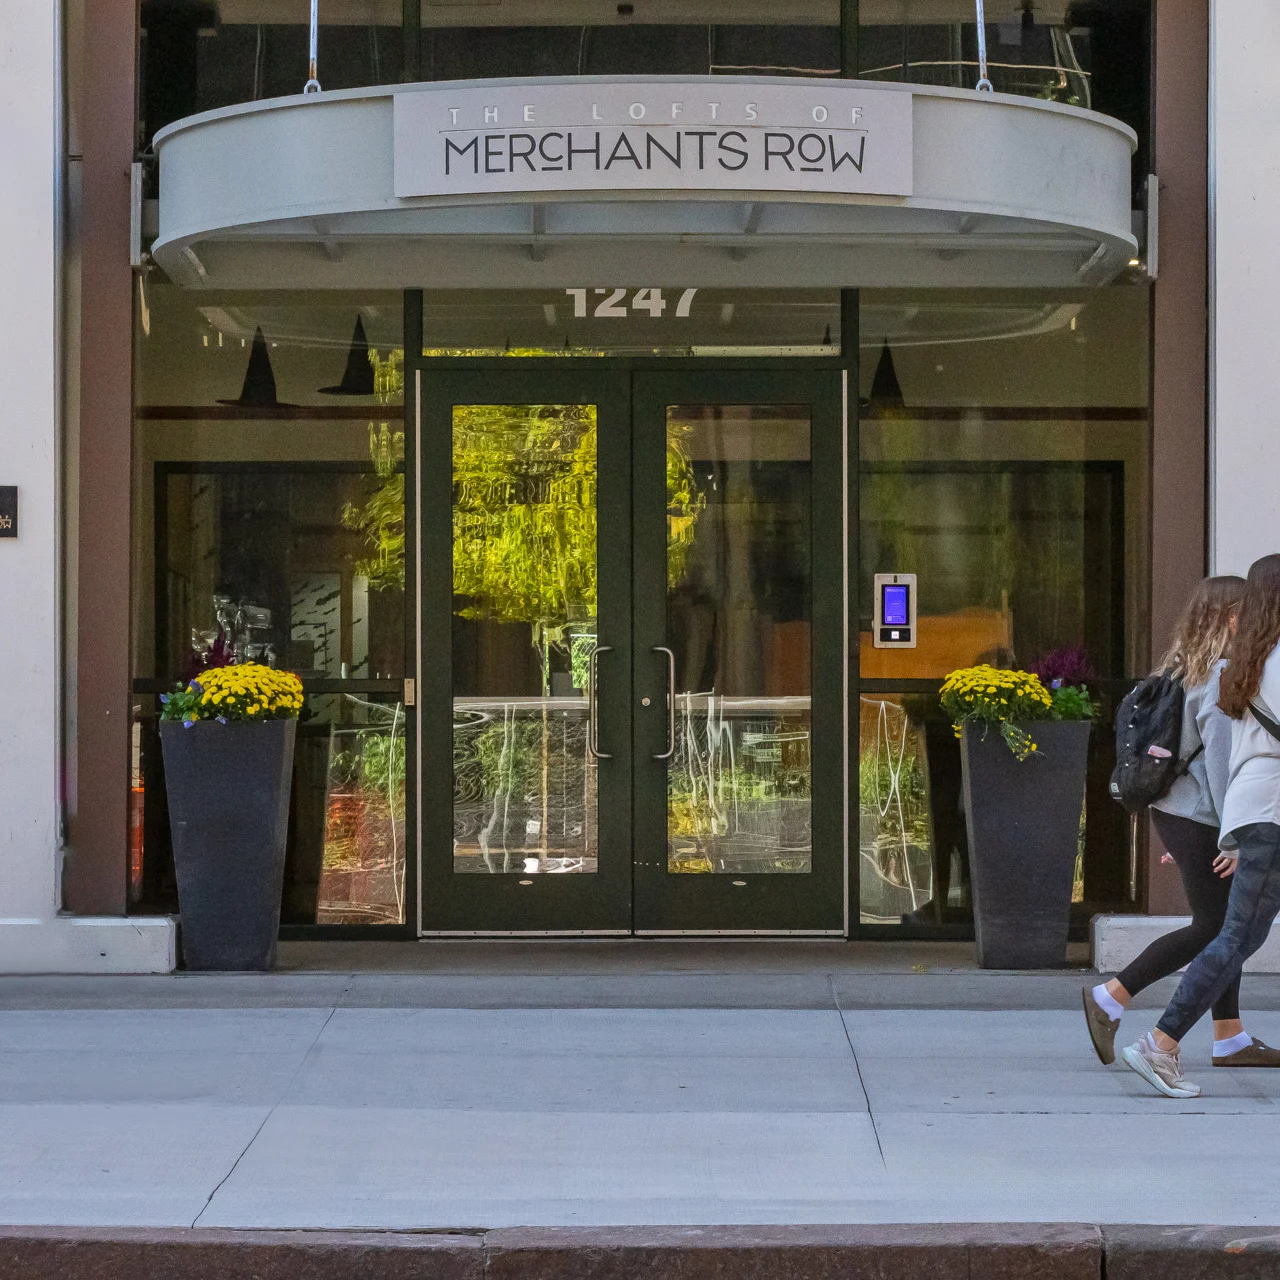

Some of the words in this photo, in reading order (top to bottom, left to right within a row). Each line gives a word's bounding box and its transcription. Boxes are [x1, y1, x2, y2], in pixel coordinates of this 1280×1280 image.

[448, 104, 536, 125] THE
[592, 102, 759, 120] LOFTS
[812, 105, 864, 124] OF
[444, 131, 750, 175] MERCHANTS
[763, 132, 866, 174] ROW
[565, 288, 699, 317] 1247
